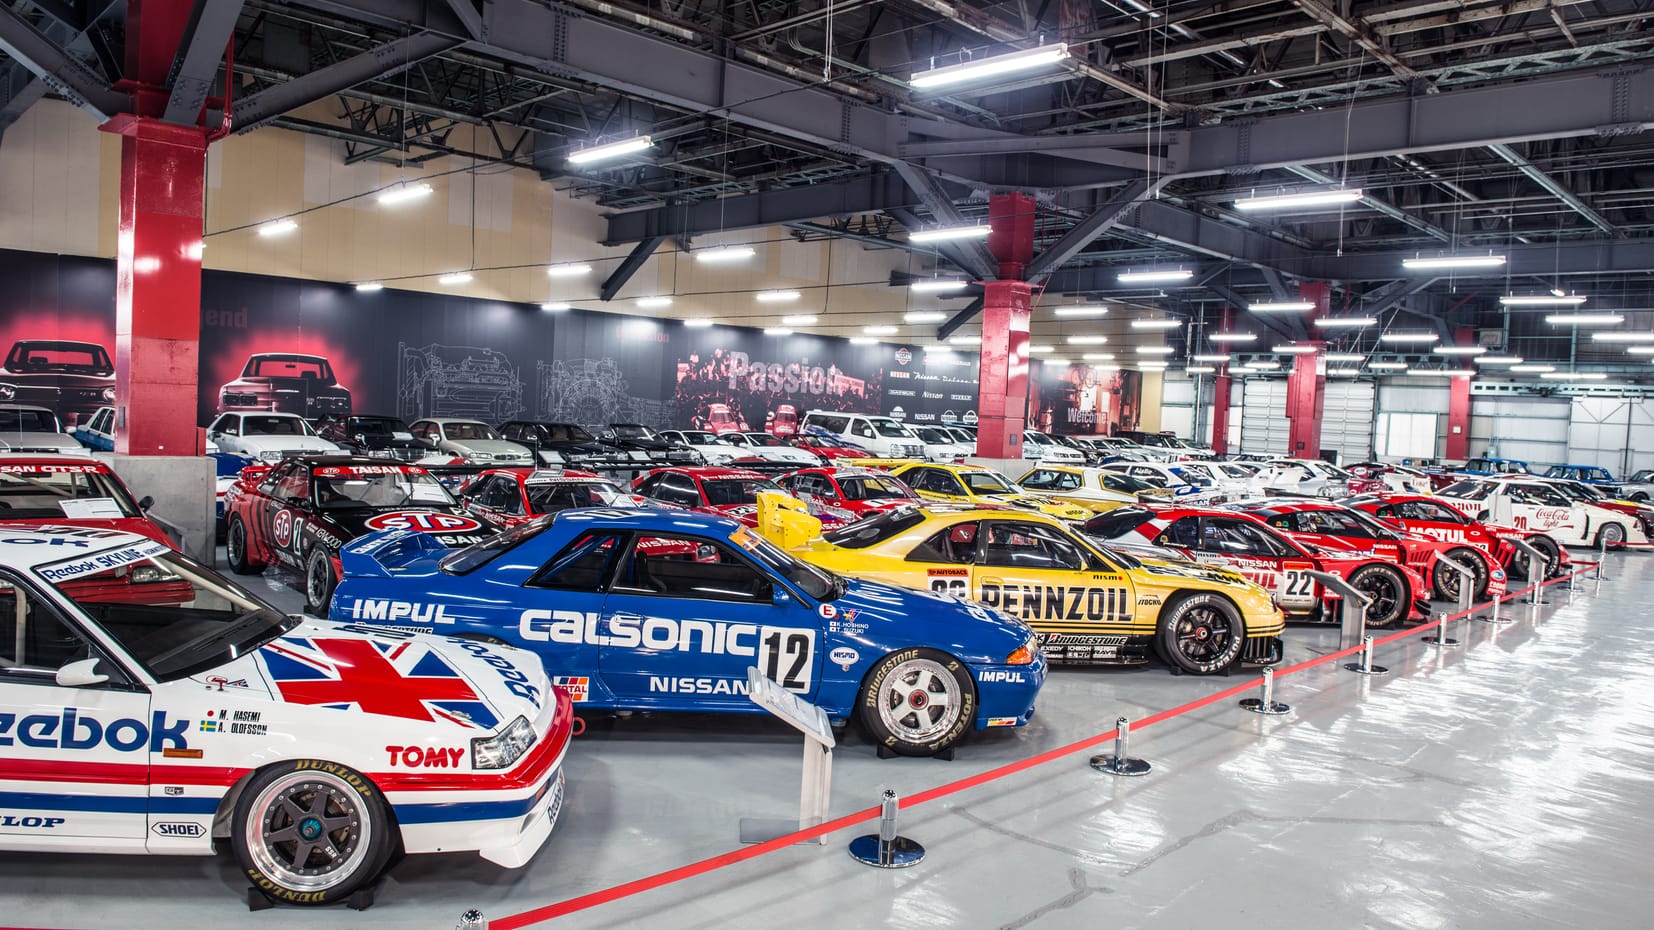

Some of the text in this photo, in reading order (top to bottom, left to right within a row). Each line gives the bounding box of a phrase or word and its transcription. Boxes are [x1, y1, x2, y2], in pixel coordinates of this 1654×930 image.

[205, 305, 248, 328] end
[729, 351, 842, 395] Passion
[922, 391, 944, 399] Nissan
[349, 466, 401, 474] TAISAN
[276, 514, 289, 540] STP
[382, 513, 464, 529] STP
[1514, 516, 1527, 529] 20
[435, 536, 483, 546] ISAN
[42, 562, 98, 580] Reebok
[96, 548, 145, 567] SKYLINE
[1238, 560, 1277, 568] NISSAN
[1286, 571, 1311, 596] 22
[823, 605, 833, 616] E
[982, 583, 1134, 622] PENNZOIL
[352, 599, 456, 625] IMPUL
[1048, 633, 1128, 645] BRIDGESTONE
[763, 631, 810, 689] 12
[866, 649, 919, 708] BRIDGESTONE
[978, 671, 1025, 683] IMPUL
[558, 685, 587, 693] OTAL
[650, 677, 750, 696] NISSAN
[219, 710, 261, 722] M. HASEMI
[928, 693, 972, 750] POTENZA
[218, 722, 267, 735] A. OLOFSSON
[385, 745, 464, 768] TOMY
[295, 759, 372, 797] DUNLOP
[0, 815, 65, 828] LOP
[160, 824, 200, 836] SHOEI
[248, 868, 328, 903] DUNLOP
